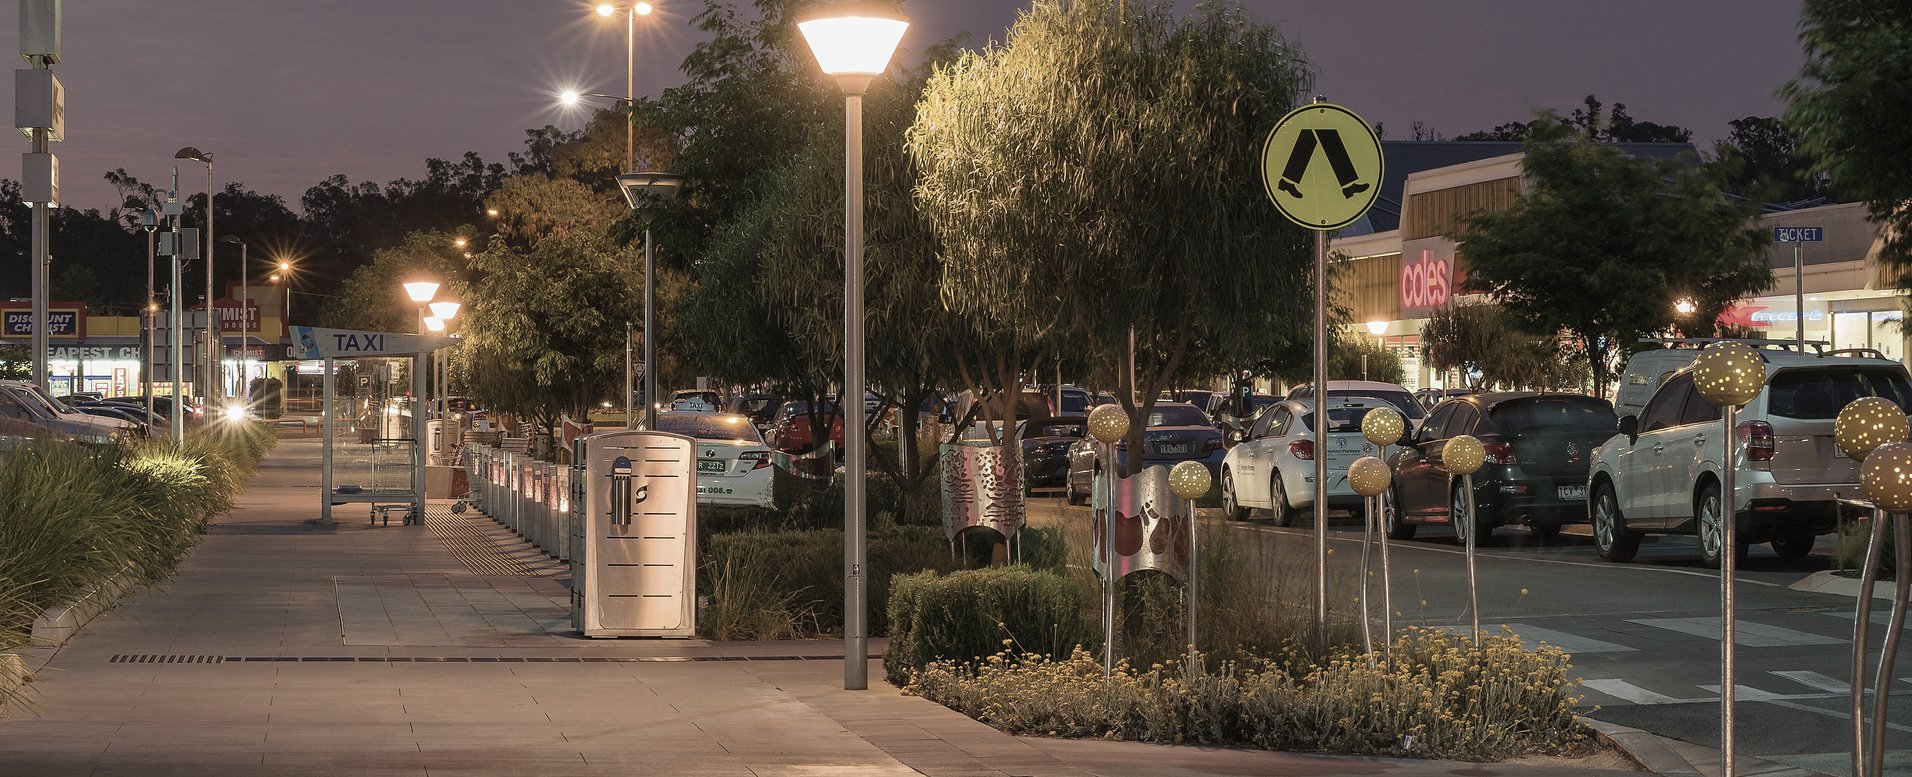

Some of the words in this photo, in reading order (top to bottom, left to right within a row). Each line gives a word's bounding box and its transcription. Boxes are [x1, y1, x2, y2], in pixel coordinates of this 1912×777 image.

[1779, 228, 1817, 241] TICKET
[1402, 250, 1446, 307] coles
[8, 315, 72, 323] DISCUNT
[222, 308, 256, 321] MIST
[14, 324, 67, 332] CHIST
[333, 334, 384, 352] TAXI
[48, 347, 112, 360] EAPEST
[360, 377, 369, 387] P
[1242, 387, 1250, 397] P
